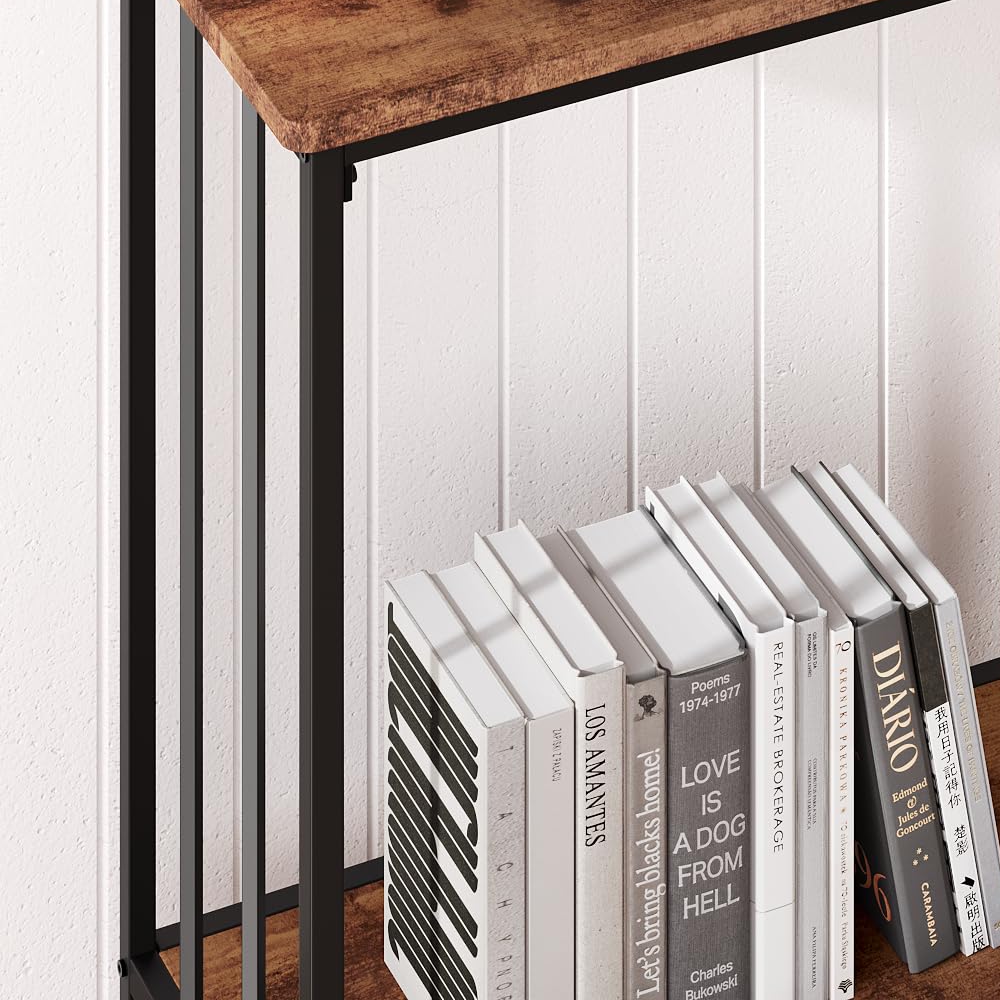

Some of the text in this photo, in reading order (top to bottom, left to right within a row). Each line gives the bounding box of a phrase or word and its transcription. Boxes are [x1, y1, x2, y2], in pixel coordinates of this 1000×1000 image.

[679, 683, 741, 713] 1974-1977
[691, 673, 730, 695] Poems
[872, 641, 919, 773] DIÁRIO
[552, 728, 561, 752] ZAPISKI
[773, 641, 784, 853] REAL-ESTATE BROKERAGE
[839, 667, 848, 802] KRONIKA PARKOWA
[585, 703, 606, 848] LOS AMANTES
[681, 749, 741, 788] LOVE
[935, 706, 961, 808] 我用日子記得你
[636, 748, 661, 818] home!
[701, 790, 722, 815] IS
[892, 778, 928, 803] Edmond
[672, 813, 746, 855] A DOG
[896, 812, 936, 838] Goncourt
[897, 802, 930, 827] Jules de
[636, 819, 660, 887] blacks
[678, 845, 743, 887] FROM
[636, 883, 666, 946] bring
[683, 883, 741, 919] HELL
[921, 882, 938, 947] CARAMBAIA
[685, 974, 738, 1000] Bukowski
[690, 961, 734, 984] Charles
